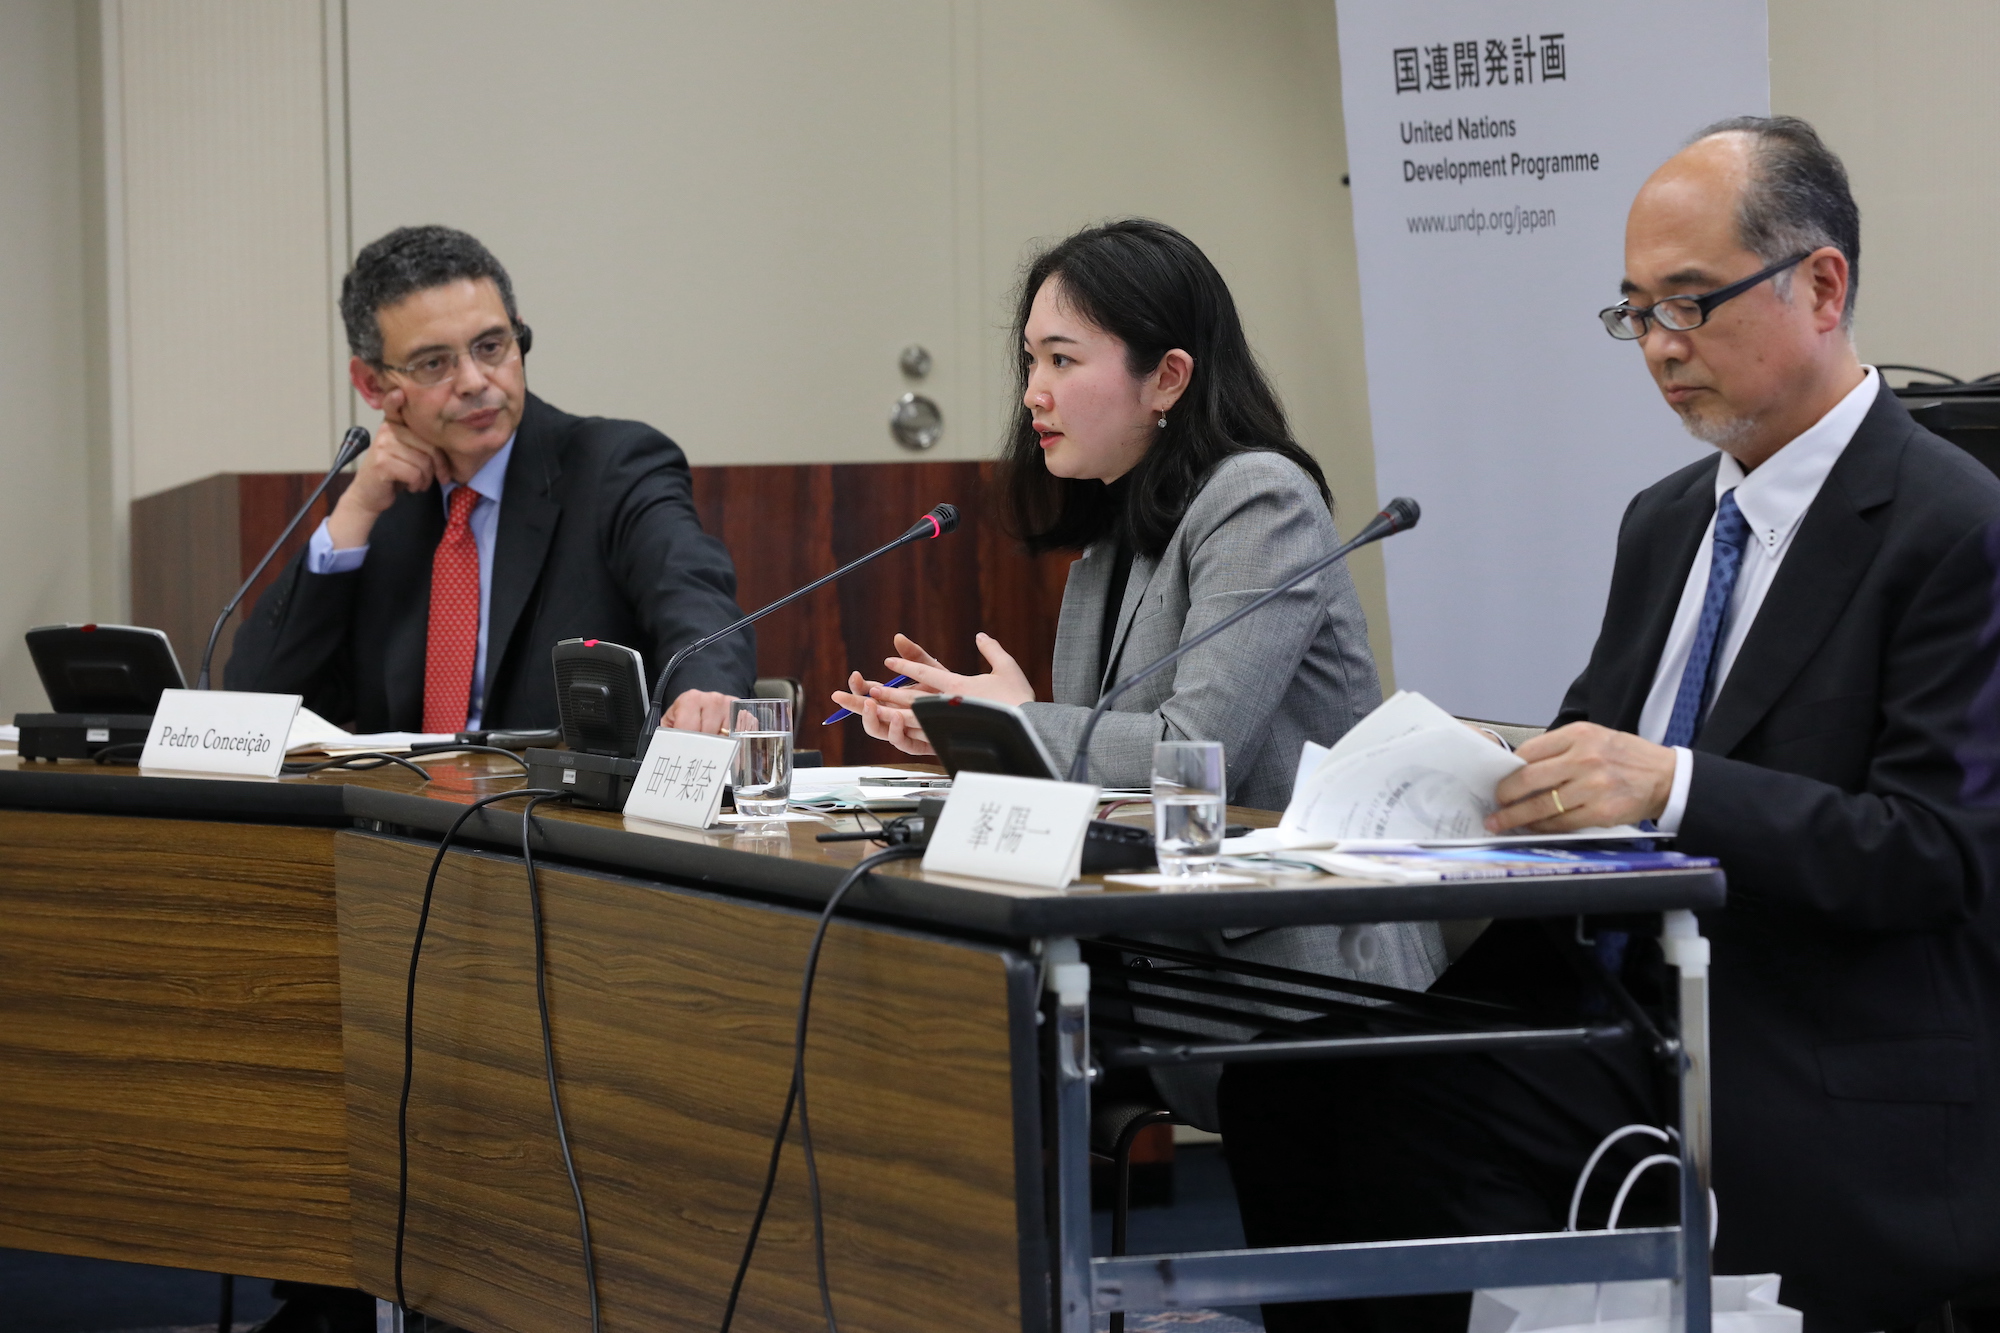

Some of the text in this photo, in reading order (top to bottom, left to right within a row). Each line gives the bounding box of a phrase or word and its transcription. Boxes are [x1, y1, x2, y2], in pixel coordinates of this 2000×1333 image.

[1393, 33, 1567, 95] 国連開発計画
[1400, 115, 1516, 144] United Nations
[1403, 152, 1599, 184] Development Programme
[1406, 205, 1556, 235] www.undp.org/japan
[159, 726, 271, 756] Pedro Conceição
[645, 756, 717, 803] 田中梨奈
